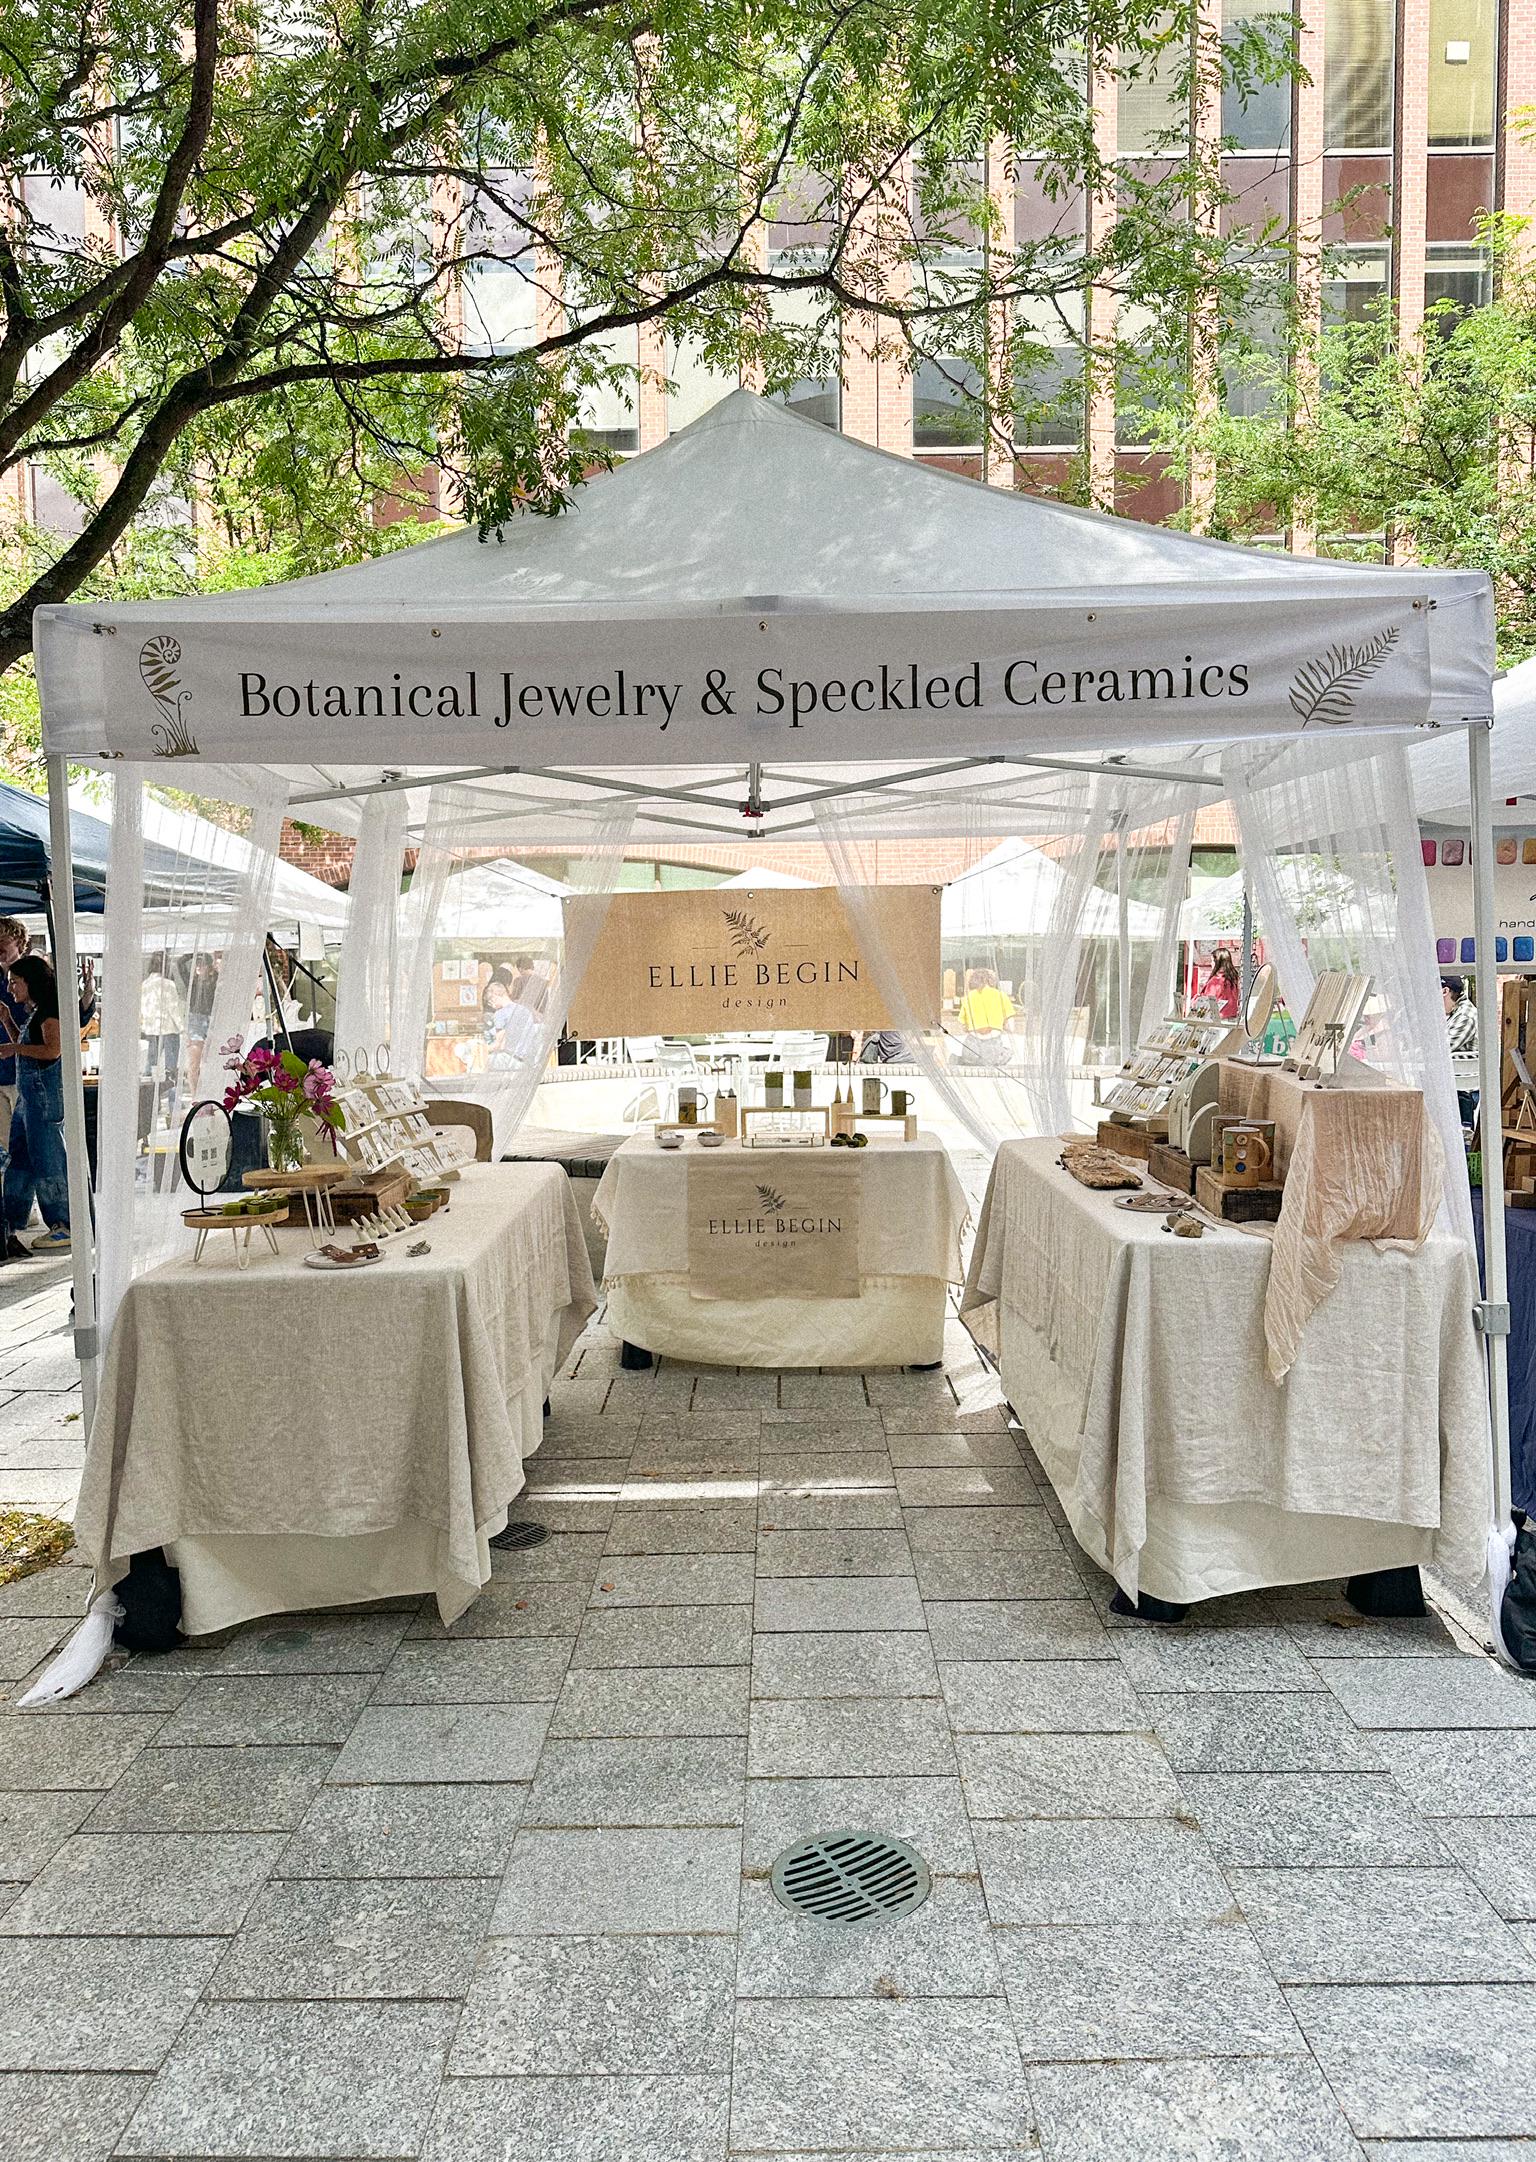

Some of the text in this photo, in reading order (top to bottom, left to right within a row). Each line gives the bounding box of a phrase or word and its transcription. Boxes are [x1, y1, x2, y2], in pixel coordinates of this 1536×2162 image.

[237, 655, 1249, 732] Botanical Jewelry & Speckled Ceramics
[648, 960, 859, 988] ELLIE BEGIN
[722, 997, 787, 1009] design
[708, 1217, 842, 1235] ELLIE BEGIN
[754, 1239, 796, 1249] design
